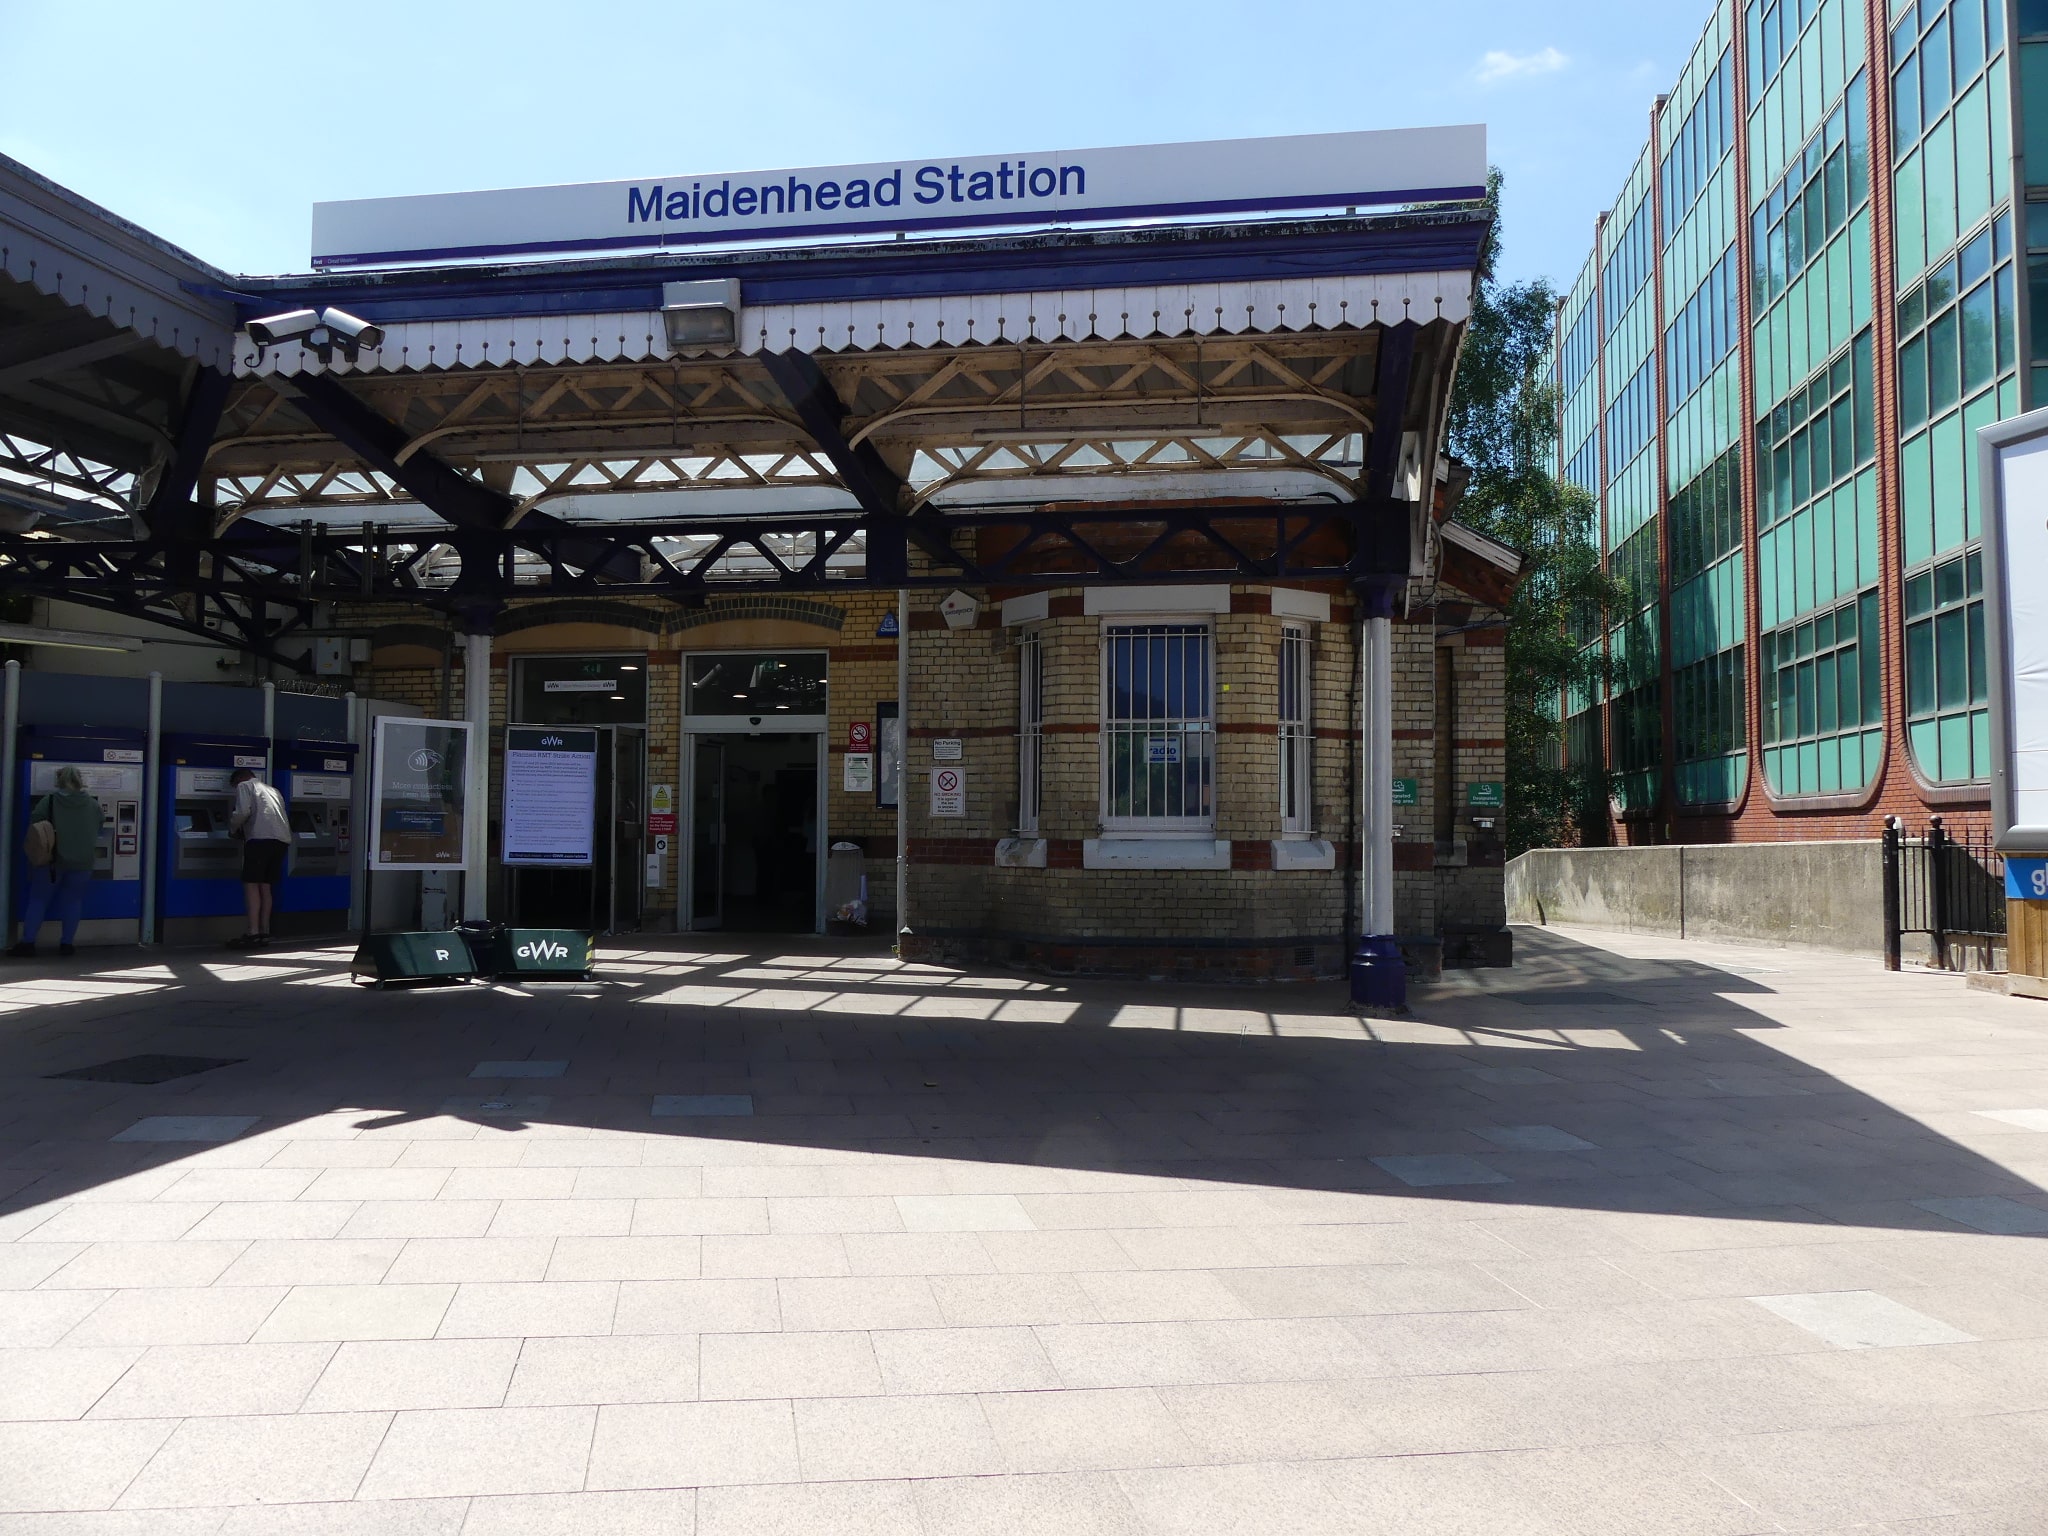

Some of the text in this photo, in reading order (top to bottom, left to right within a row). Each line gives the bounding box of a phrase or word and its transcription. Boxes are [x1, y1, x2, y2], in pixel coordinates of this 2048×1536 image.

[627, 160, 1086, 223] Maidenhead Station
[541, 735, 563, 747] GWR
[392, 781, 411, 789] More
[435, 949, 450, 961] R
[516, 938, 569, 961] GWR
